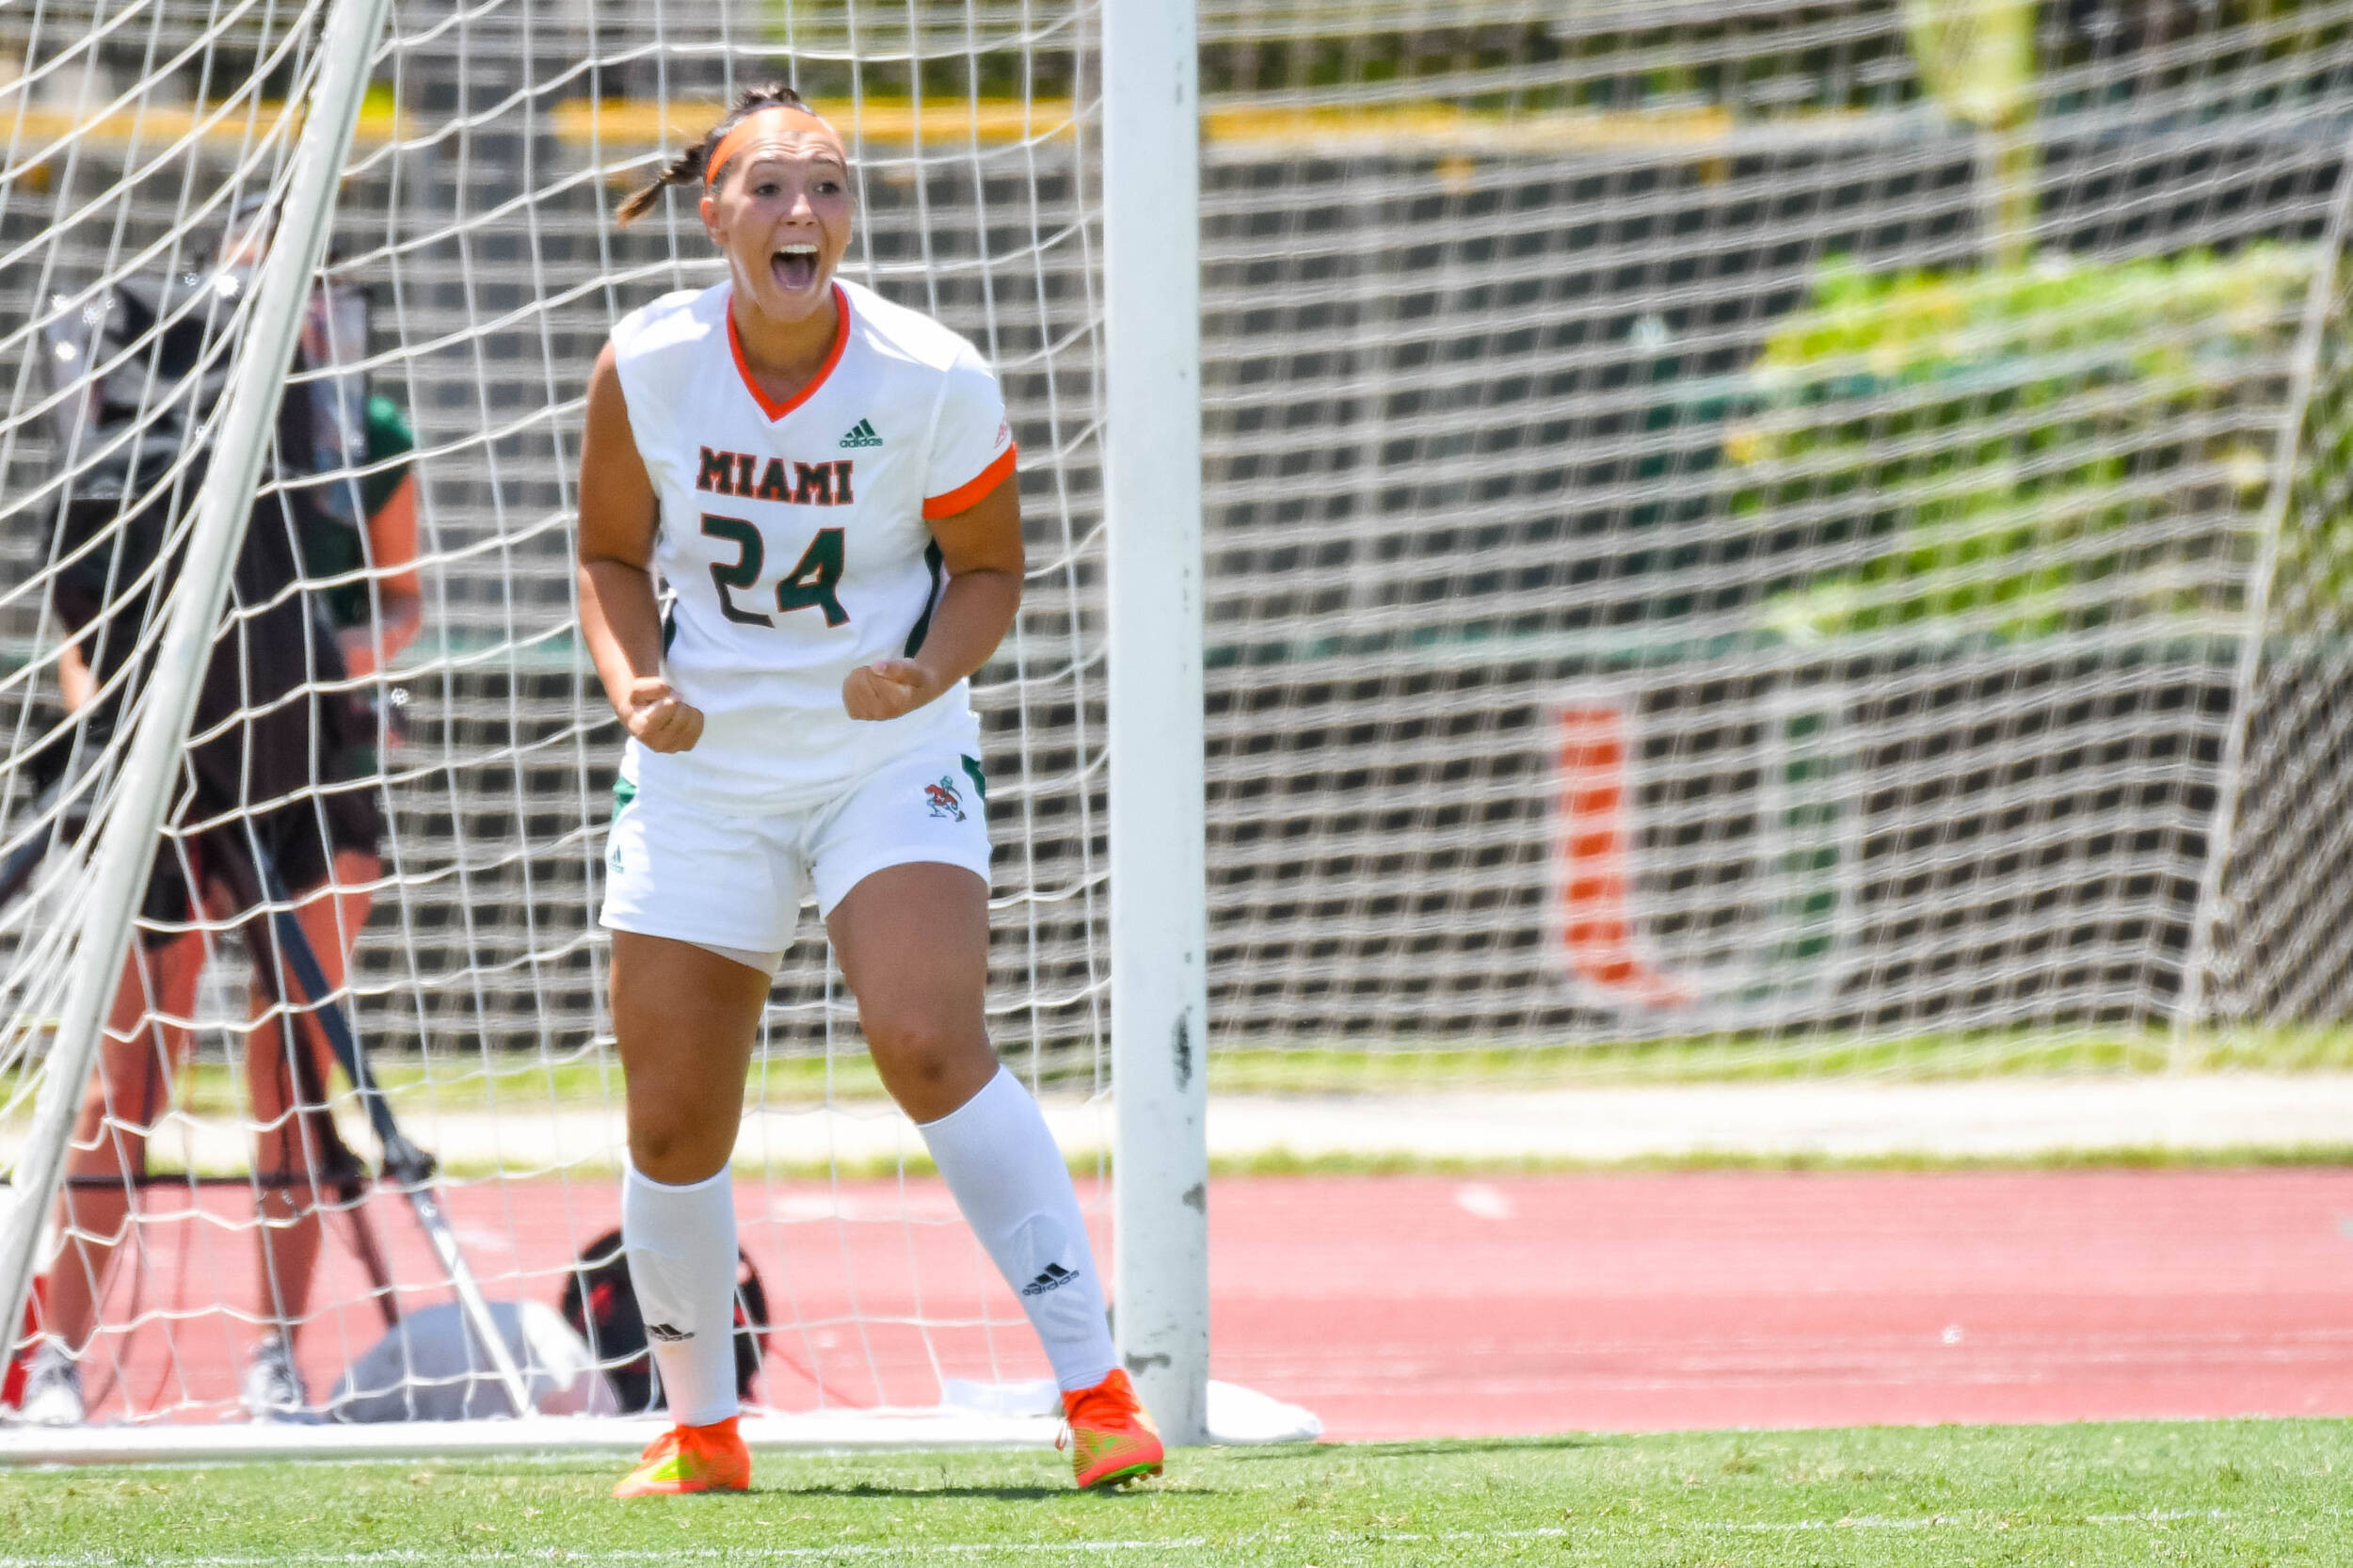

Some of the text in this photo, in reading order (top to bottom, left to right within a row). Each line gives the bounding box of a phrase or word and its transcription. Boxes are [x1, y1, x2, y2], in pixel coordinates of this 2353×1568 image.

[840, 436, 883, 449] adidas
[696, 445, 854, 506] MIAMI
[700, 512, 850, 629] 24
[1022, 1270, 1080, 1296] adidas
